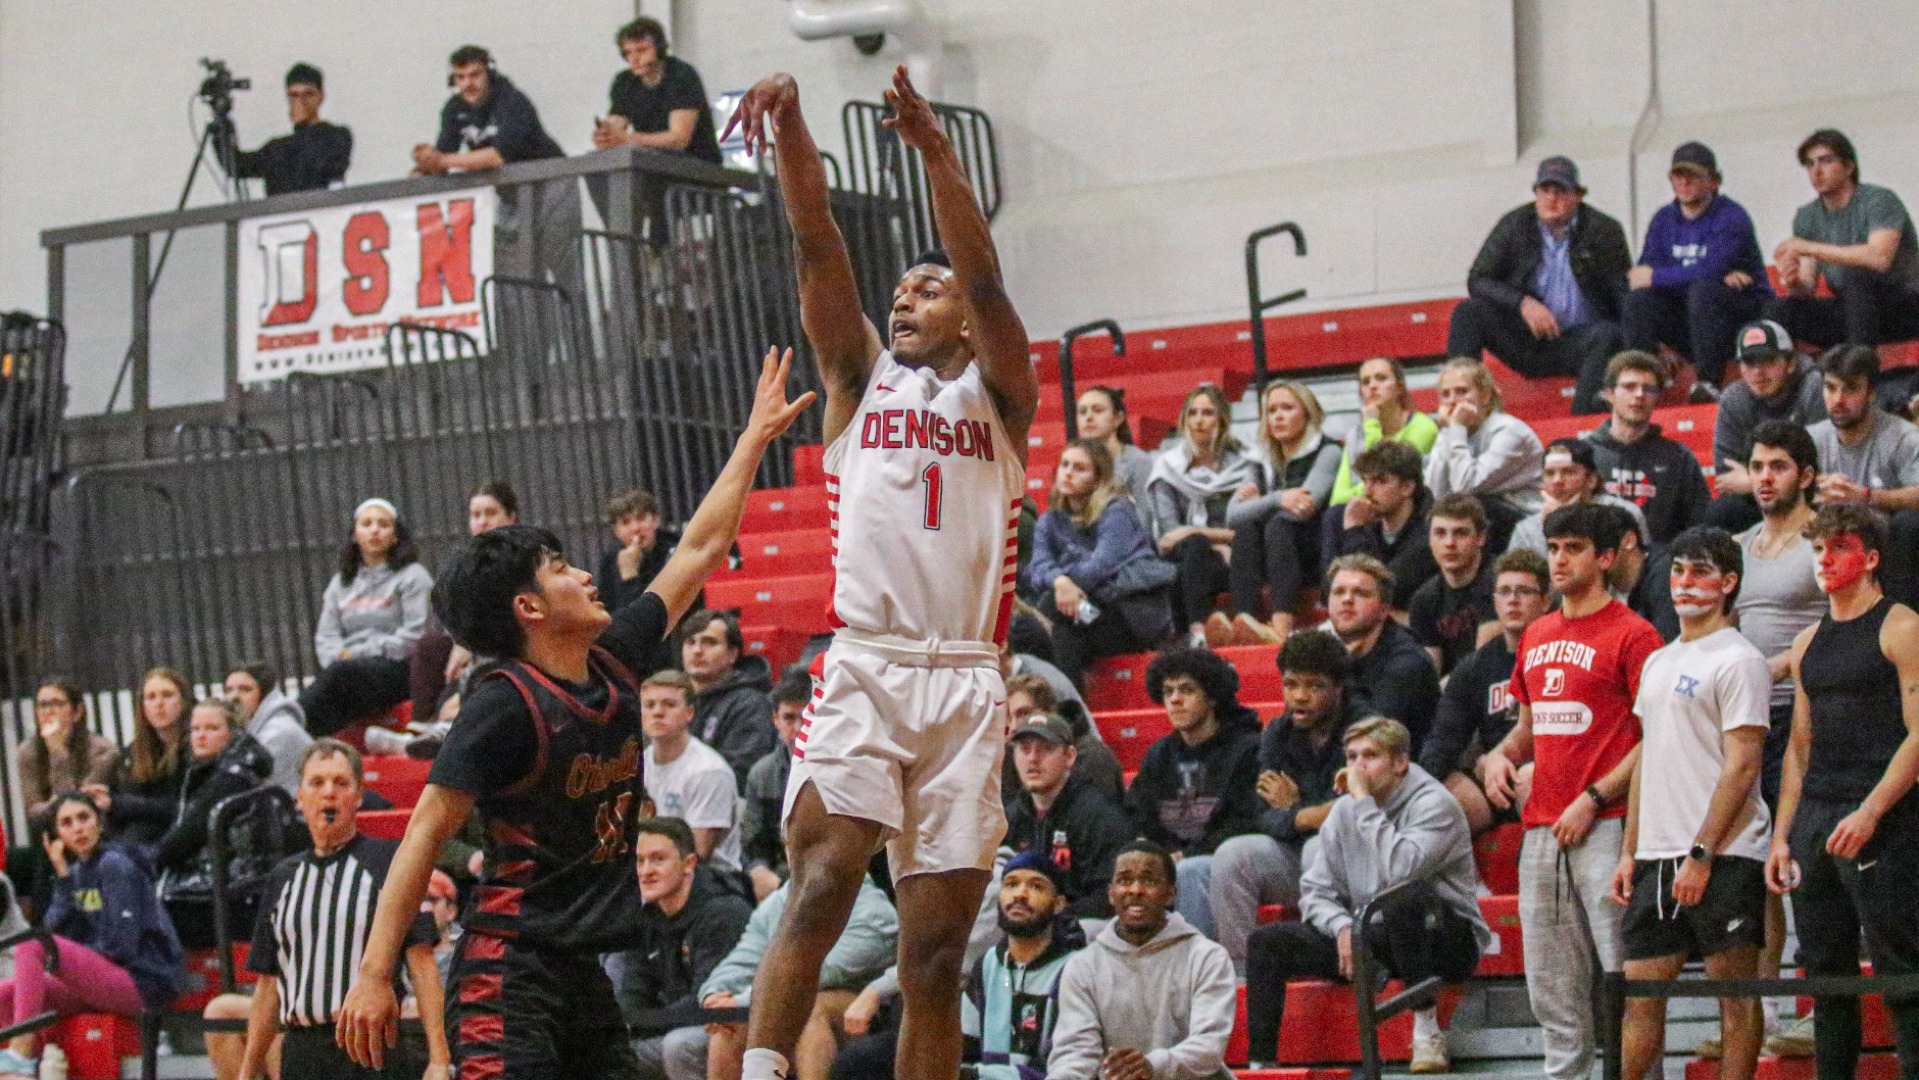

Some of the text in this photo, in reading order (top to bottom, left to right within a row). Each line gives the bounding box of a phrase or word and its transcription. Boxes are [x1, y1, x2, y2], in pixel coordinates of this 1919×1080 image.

[258, 199, 475, 327] DSN
[861, 409, 995, 461] DENISON
[922, 461, 943, 531] 1
[1525, 641, 1597, 672] DENISON
[1548, 711, 1583, 724] SOCCER
